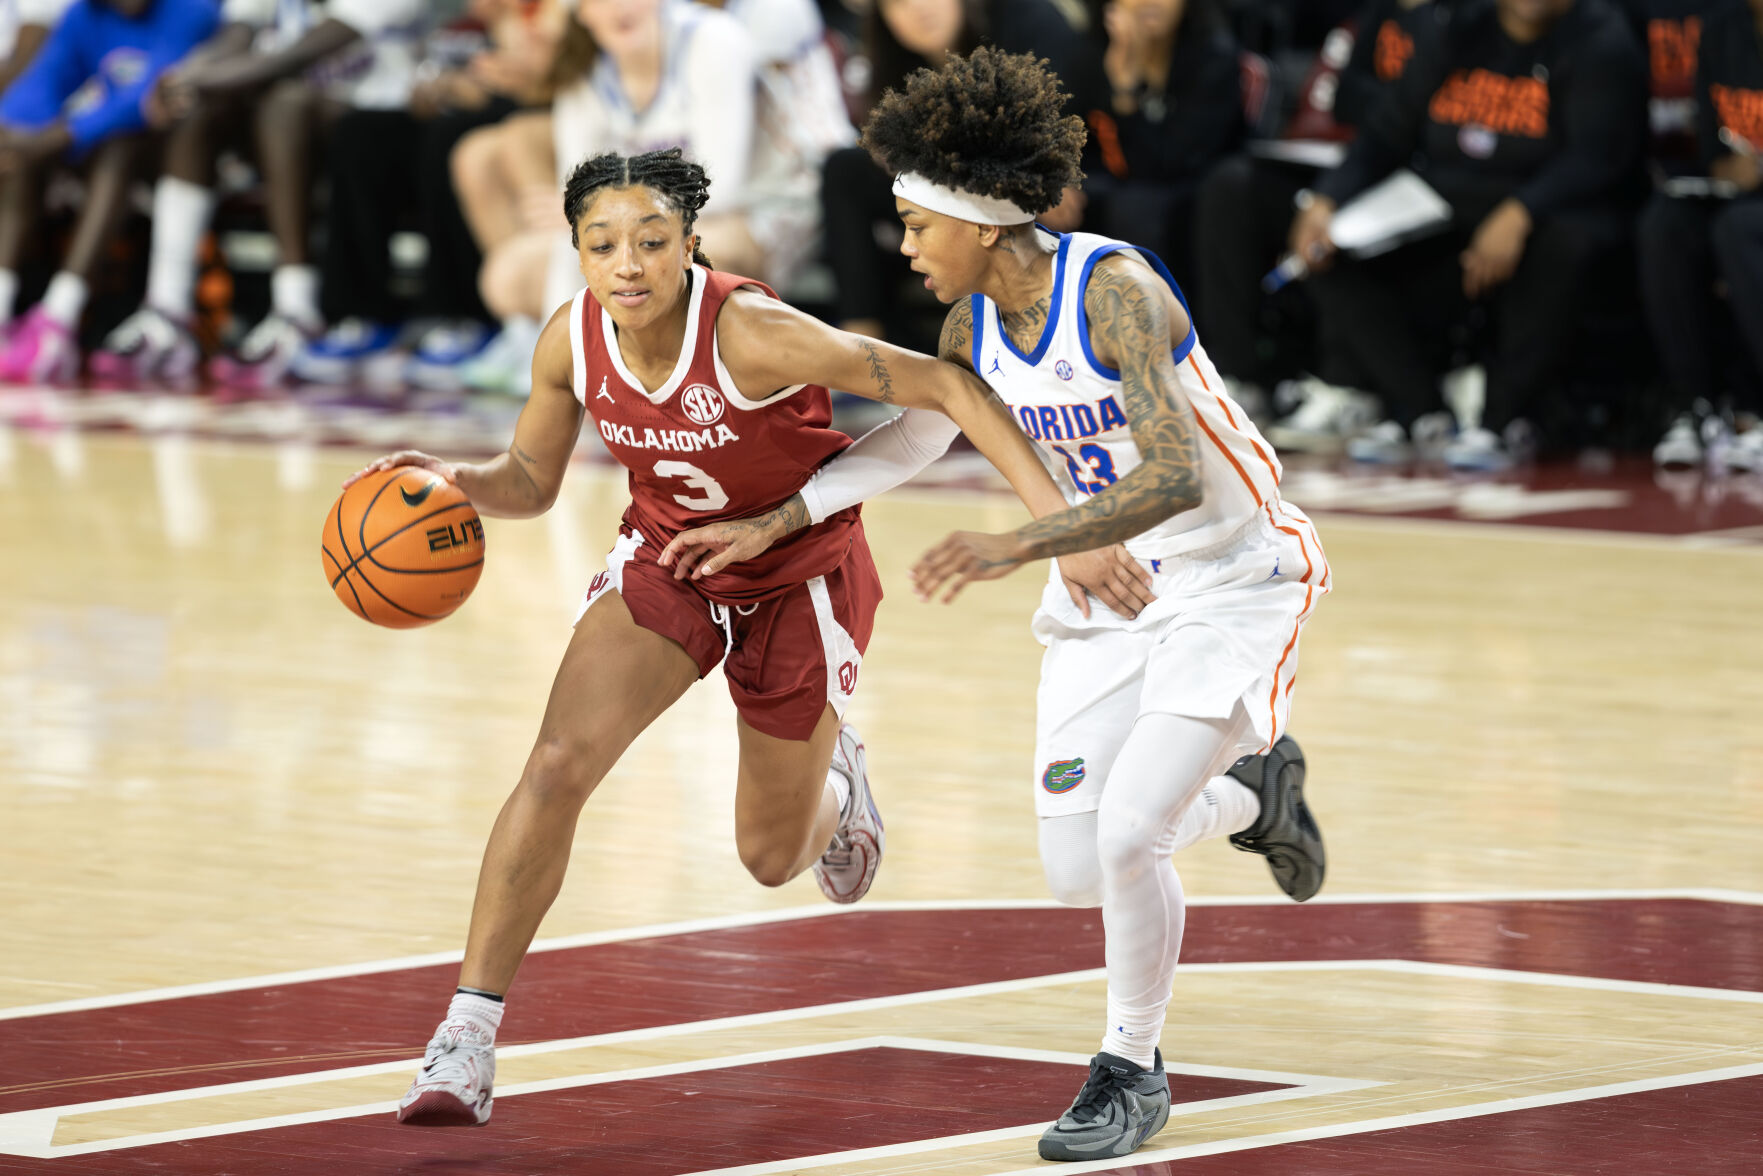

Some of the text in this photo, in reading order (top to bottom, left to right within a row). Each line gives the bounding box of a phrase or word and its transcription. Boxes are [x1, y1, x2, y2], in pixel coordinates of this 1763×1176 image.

[684, 386, 721, 422] SEC
[1005, 395, 1128, 442] ORIDA
[600, 419, 740, 452] OKLAHOMA
[653, 459, 730, 511] 3
[426, 517, 485, 553] ELITE
[838, 660, 858, 696] OU
